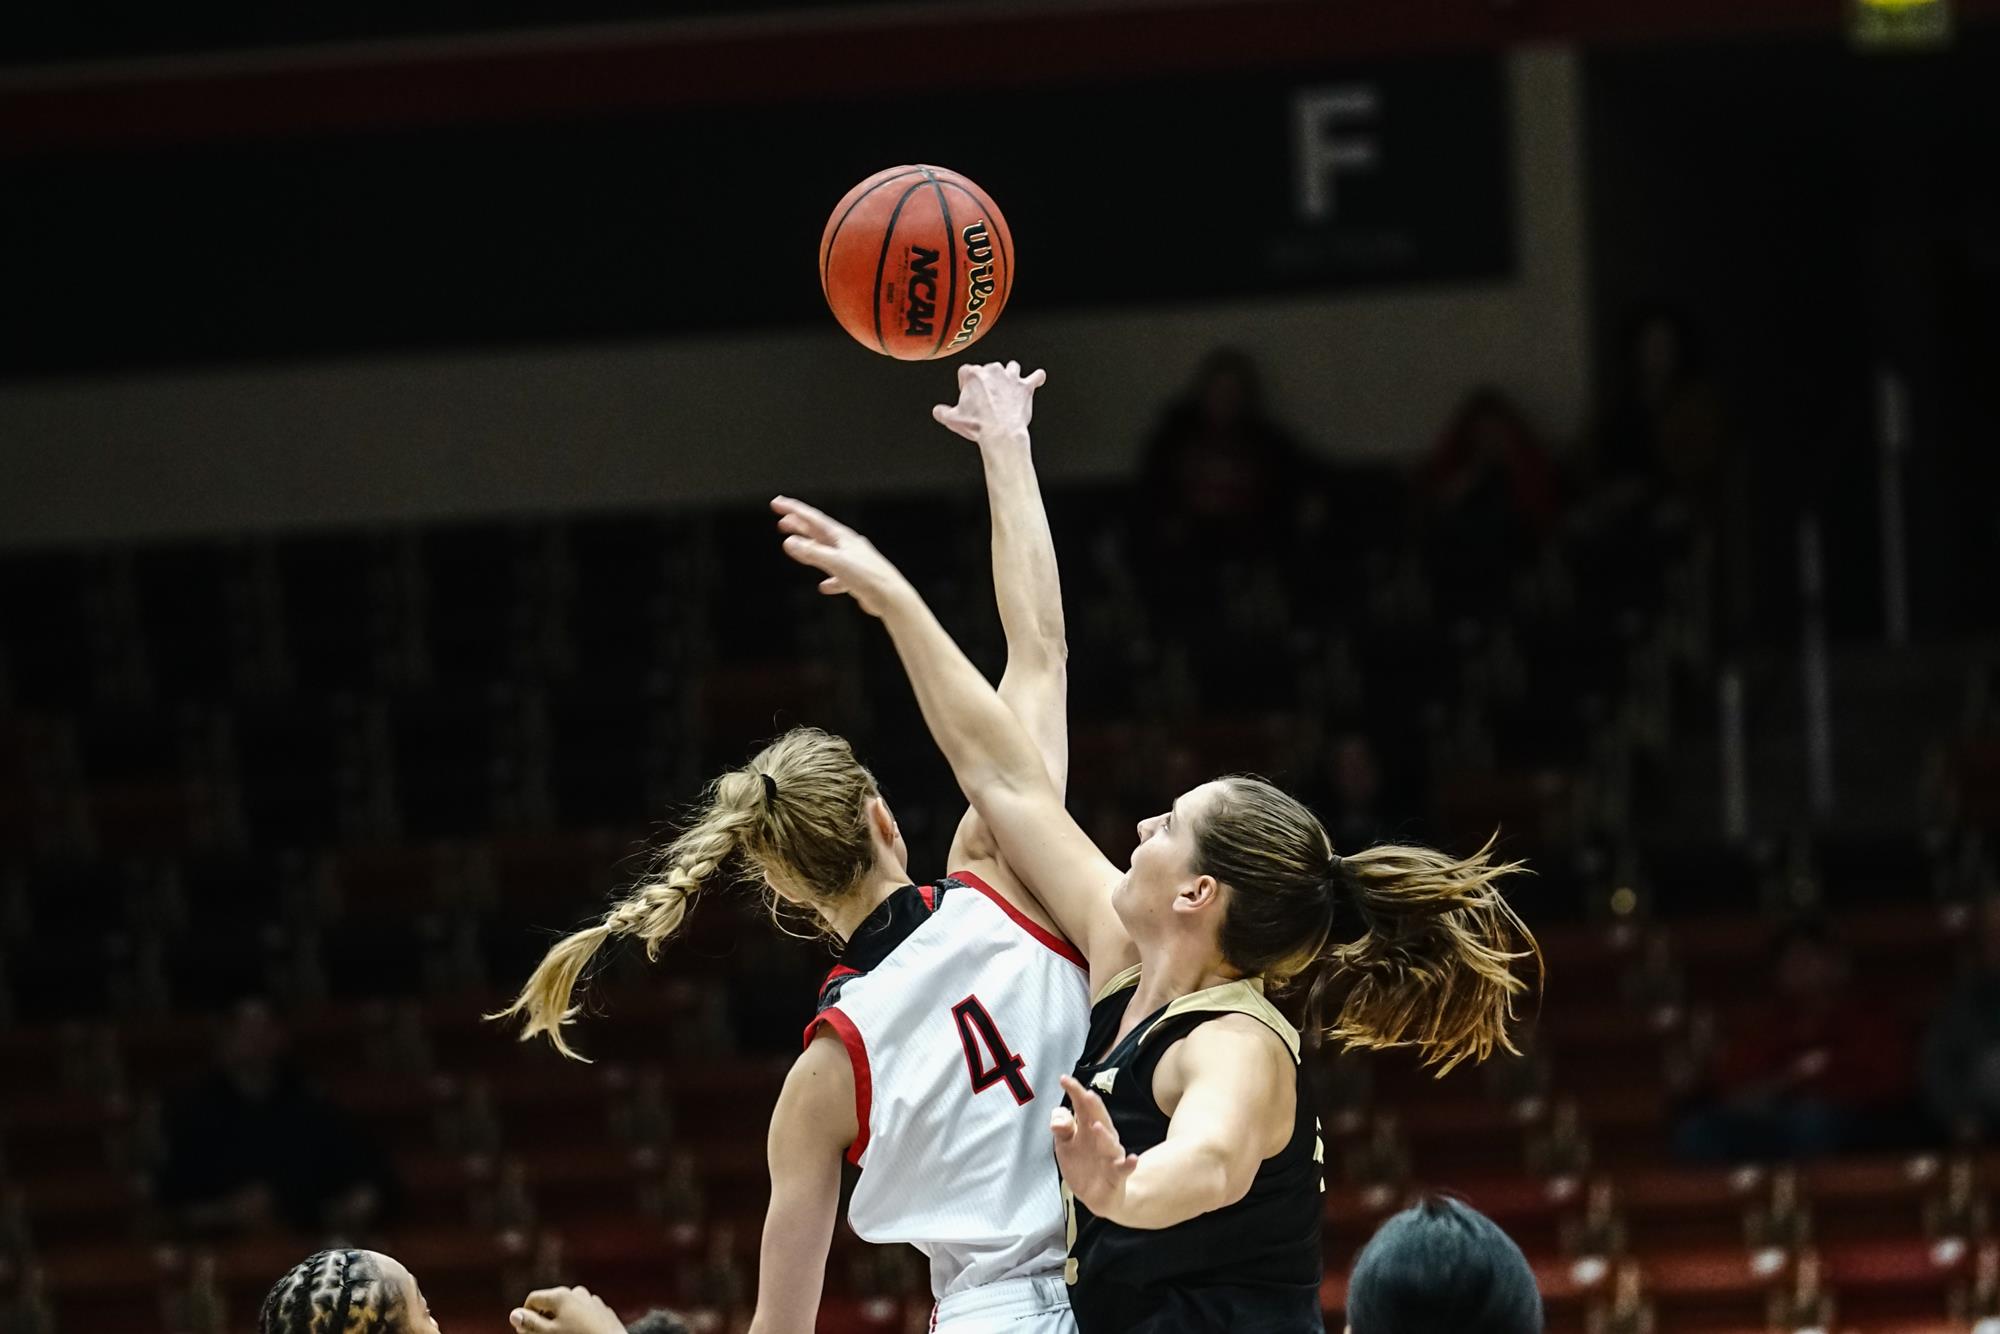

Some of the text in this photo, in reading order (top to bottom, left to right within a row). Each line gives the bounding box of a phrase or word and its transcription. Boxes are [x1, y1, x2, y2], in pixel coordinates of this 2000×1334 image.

[1292, 85, 1381, 221] F
[905, 245, 940, 336] NCAA
[948, 219, 995, 349] Wilson
[951, 993, 1035, 1106] 4
